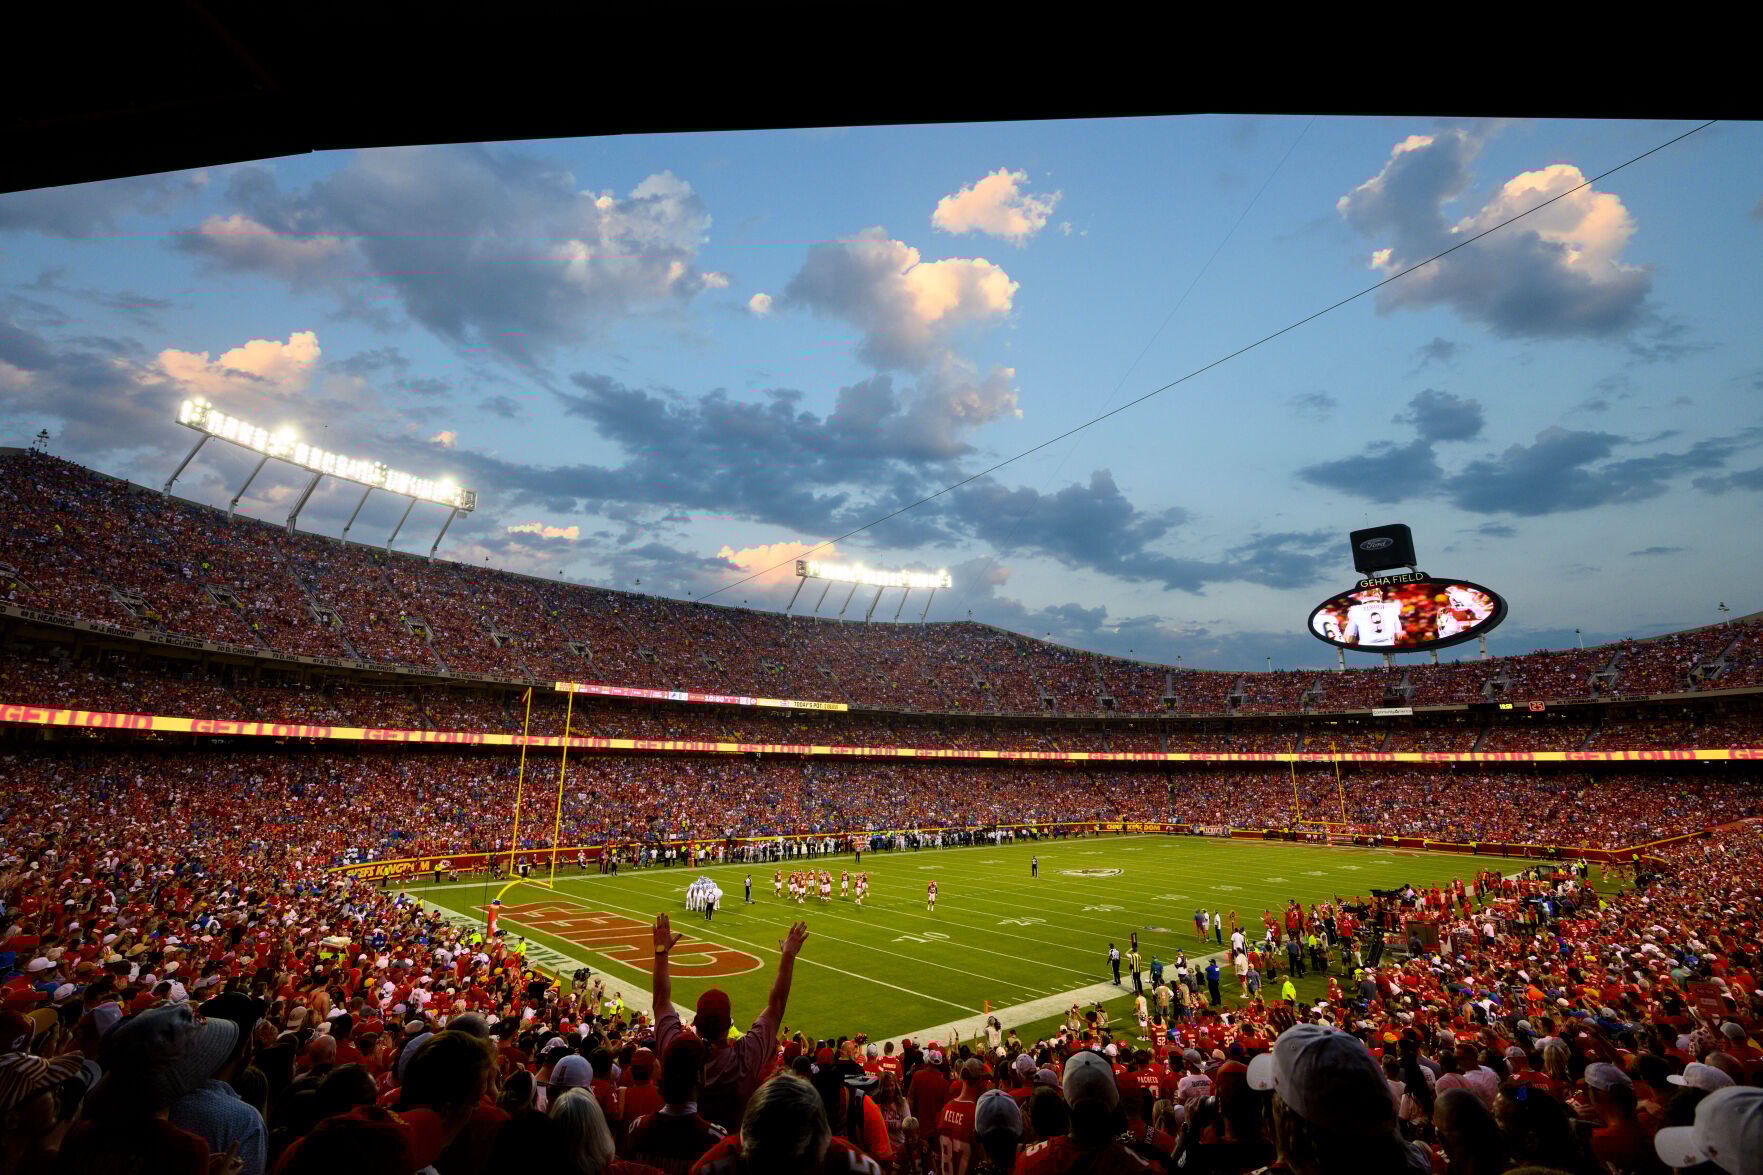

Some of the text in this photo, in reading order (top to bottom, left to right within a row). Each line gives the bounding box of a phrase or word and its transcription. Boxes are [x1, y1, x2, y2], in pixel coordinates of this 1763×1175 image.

[1360, 572, 1424, 588] GEHA FIELD
[38, 613, 75, 627] HEADRICK
[106, 627, 136, 639] RUDNAY
[232, 648, 259, 657] CHERRY
[1530, 702, 1544, 711] 25
[891, 931, 951, 944] 10
[1156, 1036, 1166, 1046] 52
[944, 1110, 964, 1126] KELCE
[939, 1134, 972, 1175] 87
